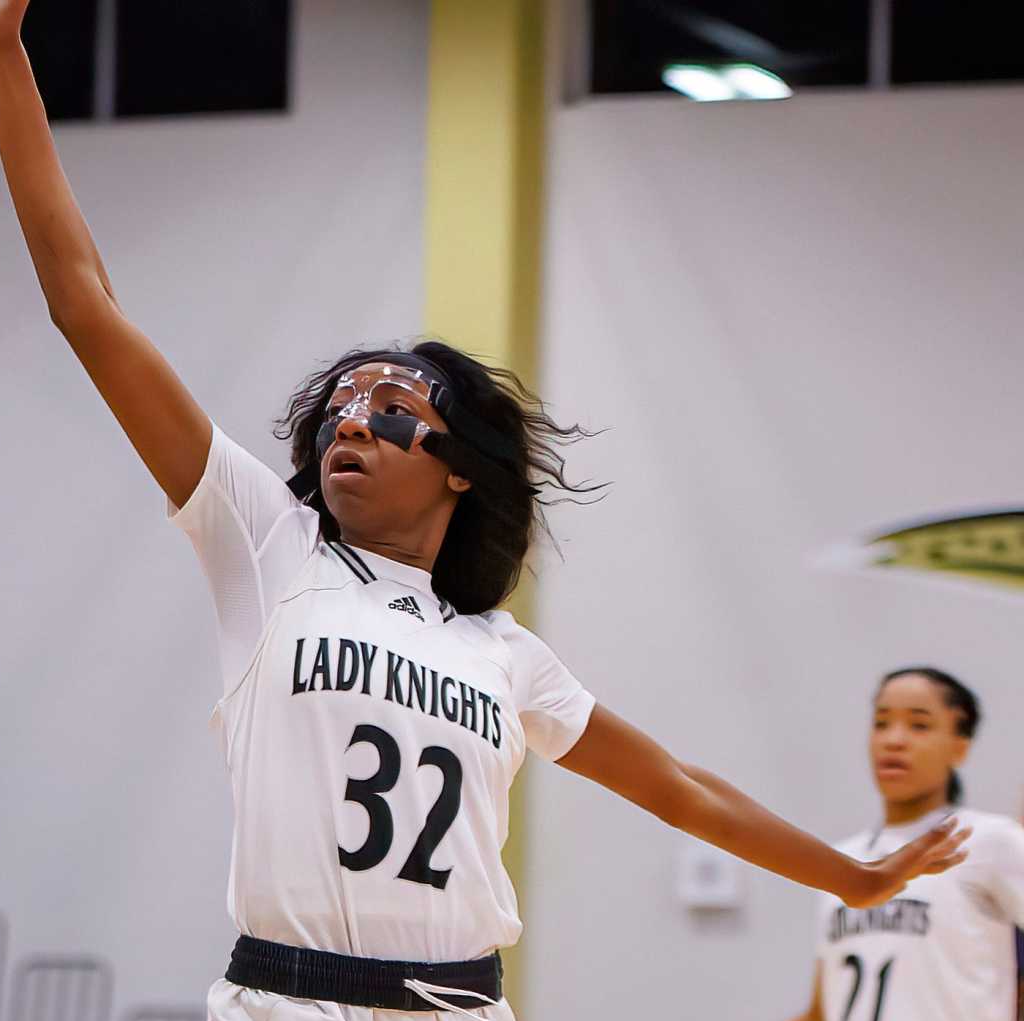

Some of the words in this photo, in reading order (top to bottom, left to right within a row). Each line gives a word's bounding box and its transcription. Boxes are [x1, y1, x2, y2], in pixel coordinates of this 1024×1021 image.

[291, 637, 378, 697] LADY
[384, 650, 501, 750] KNIGHTS
[337, 724, 463, 890] 32
